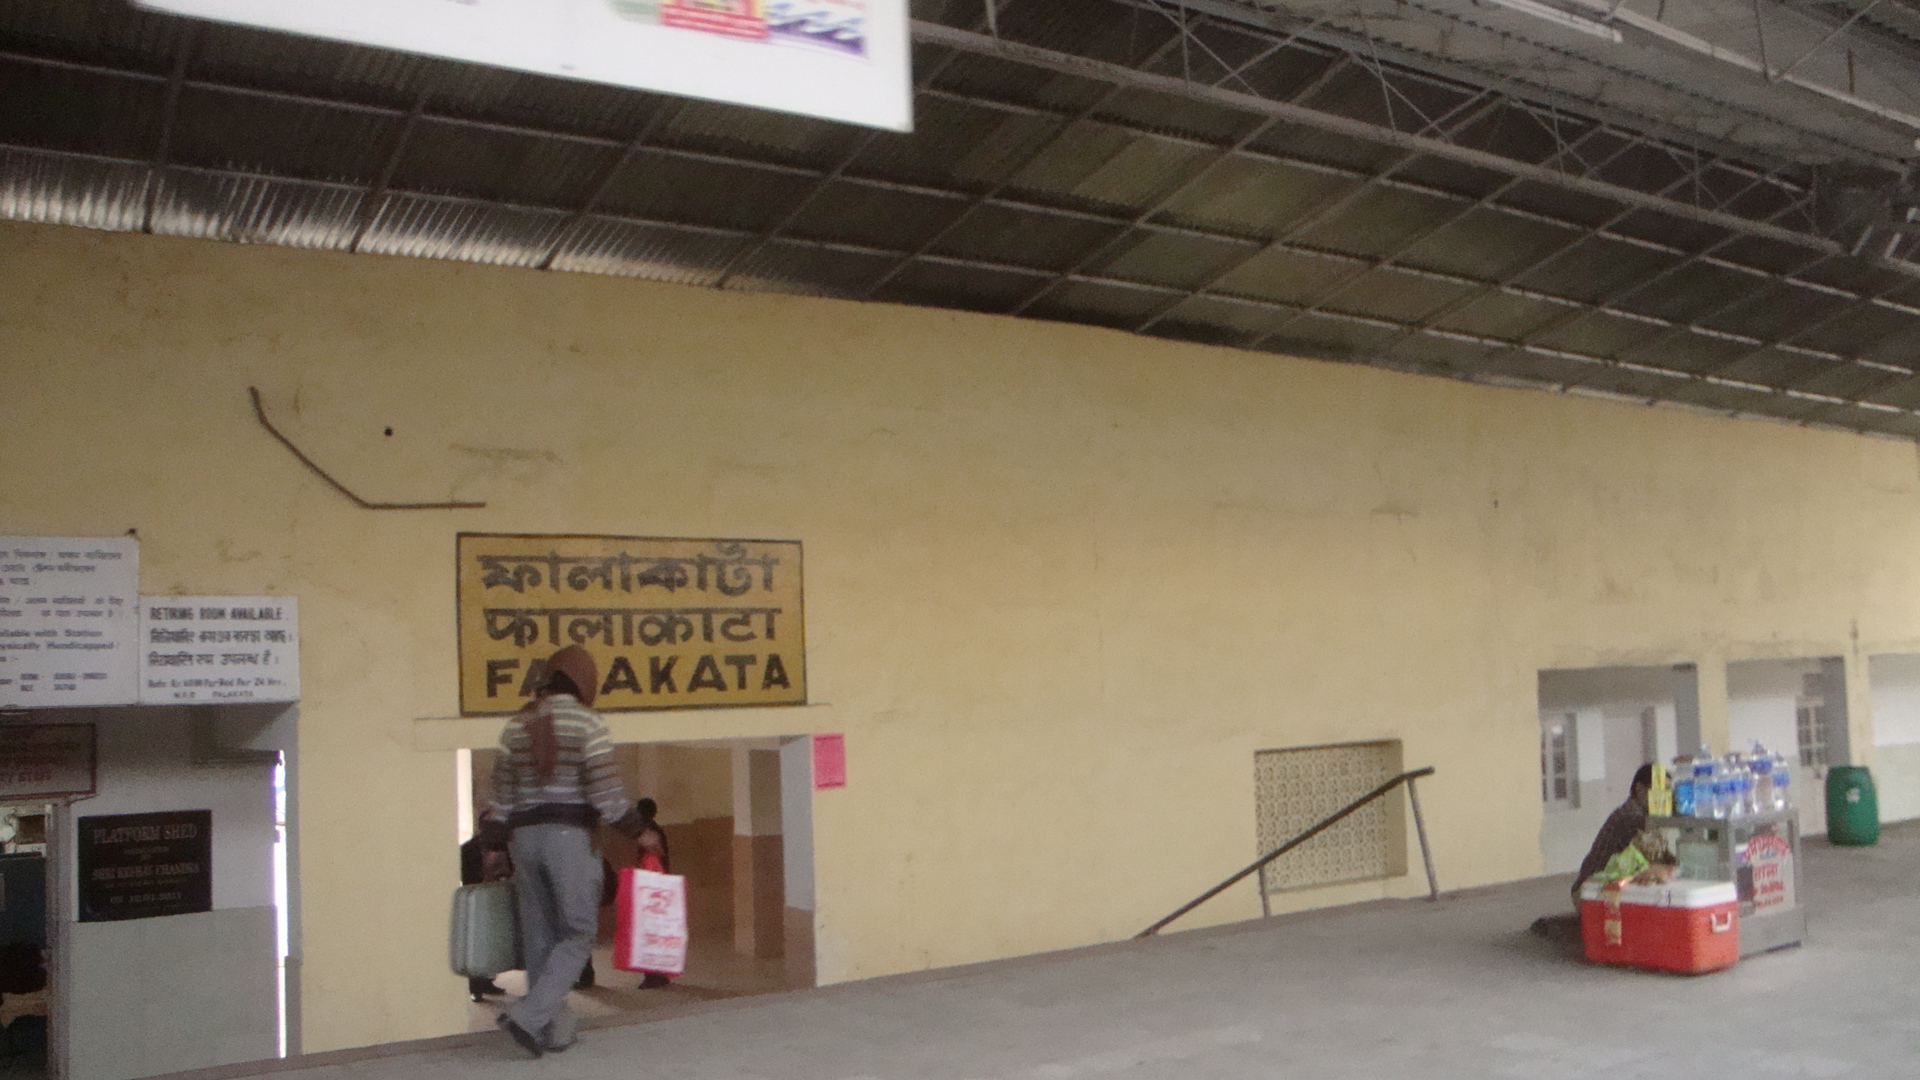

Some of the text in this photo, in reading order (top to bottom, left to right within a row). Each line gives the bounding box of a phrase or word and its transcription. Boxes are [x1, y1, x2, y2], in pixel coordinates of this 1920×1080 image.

[477, 543, 780, 596] ফালাকাটা
[230, 607, 283, 620] AVAILABLE
[483, 607, 782, 648] फालाकाटा
[486, 653, 790, 697] FAAKATA
[162, 823, 198, 840] SHED
